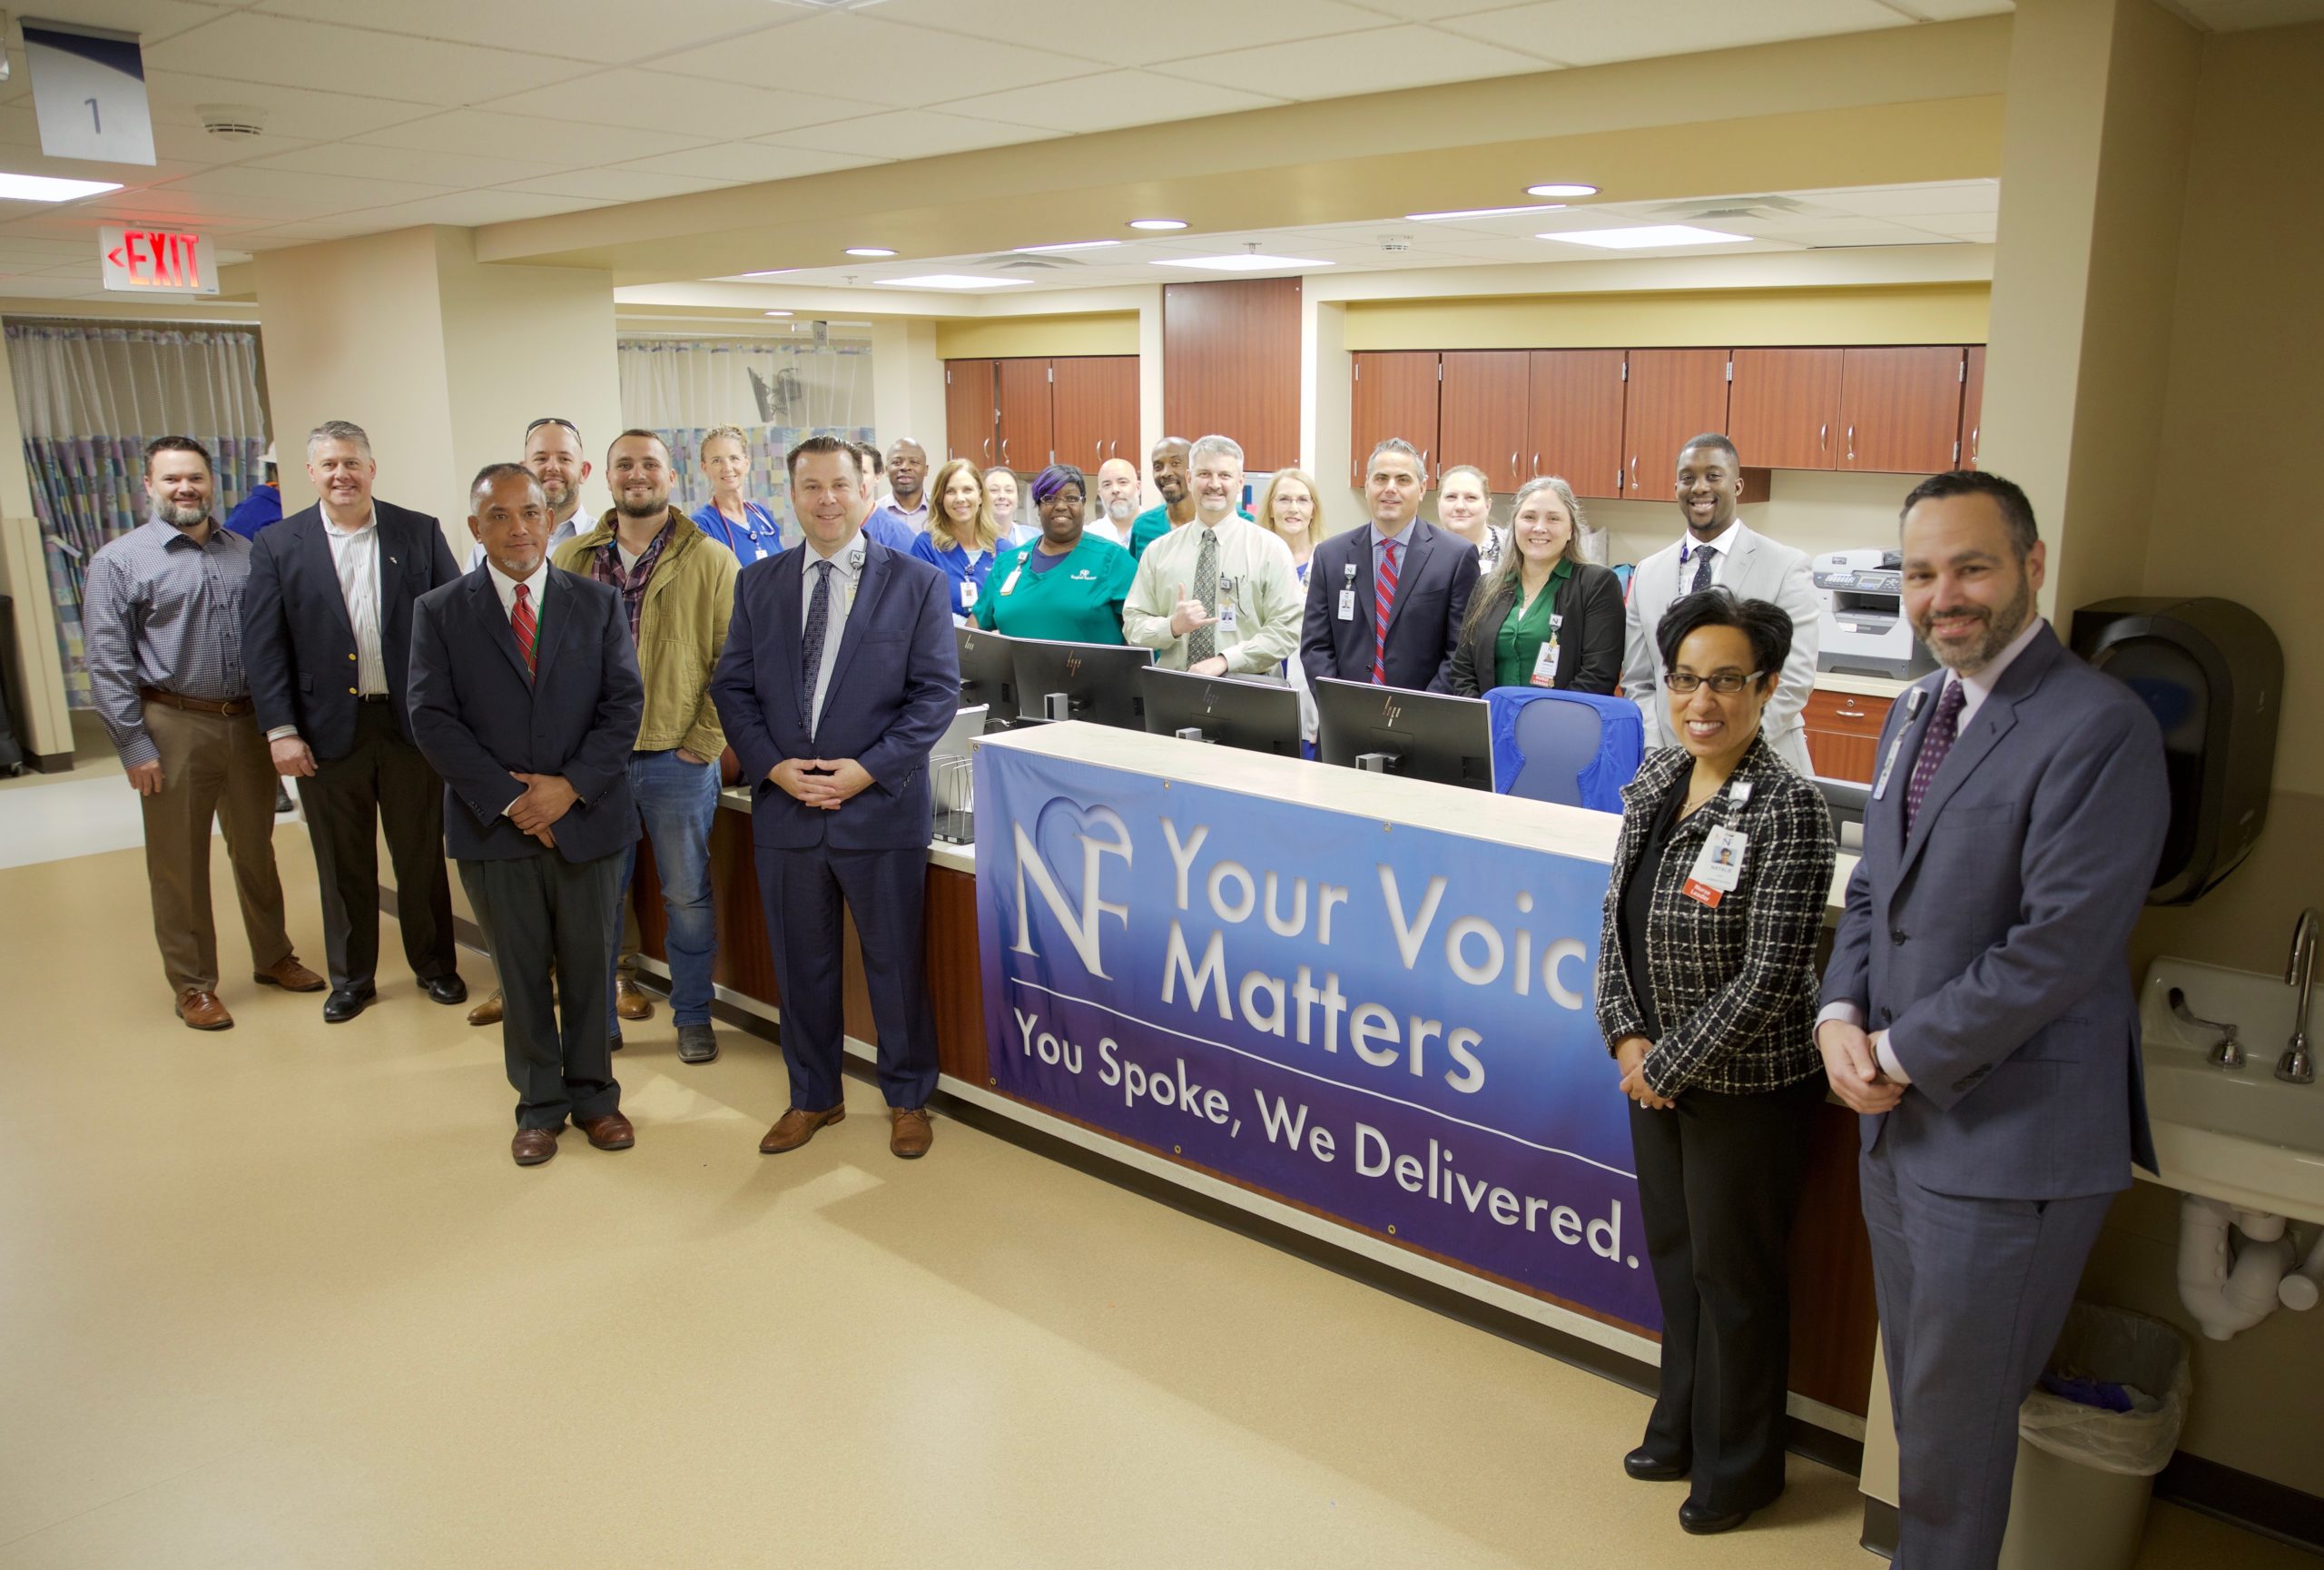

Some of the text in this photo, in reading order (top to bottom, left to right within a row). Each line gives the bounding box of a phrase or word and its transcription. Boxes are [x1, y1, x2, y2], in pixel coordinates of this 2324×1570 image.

[84, 97, 102, 135] 1
[123, 230, 200, 289] EXIT
[1158, 815, 1600, 1012] Your Voic
[1160, 917, 1486, 1094] Matters
[1013, 1006, 1640, 1270] You Spoke, We Delivered.
